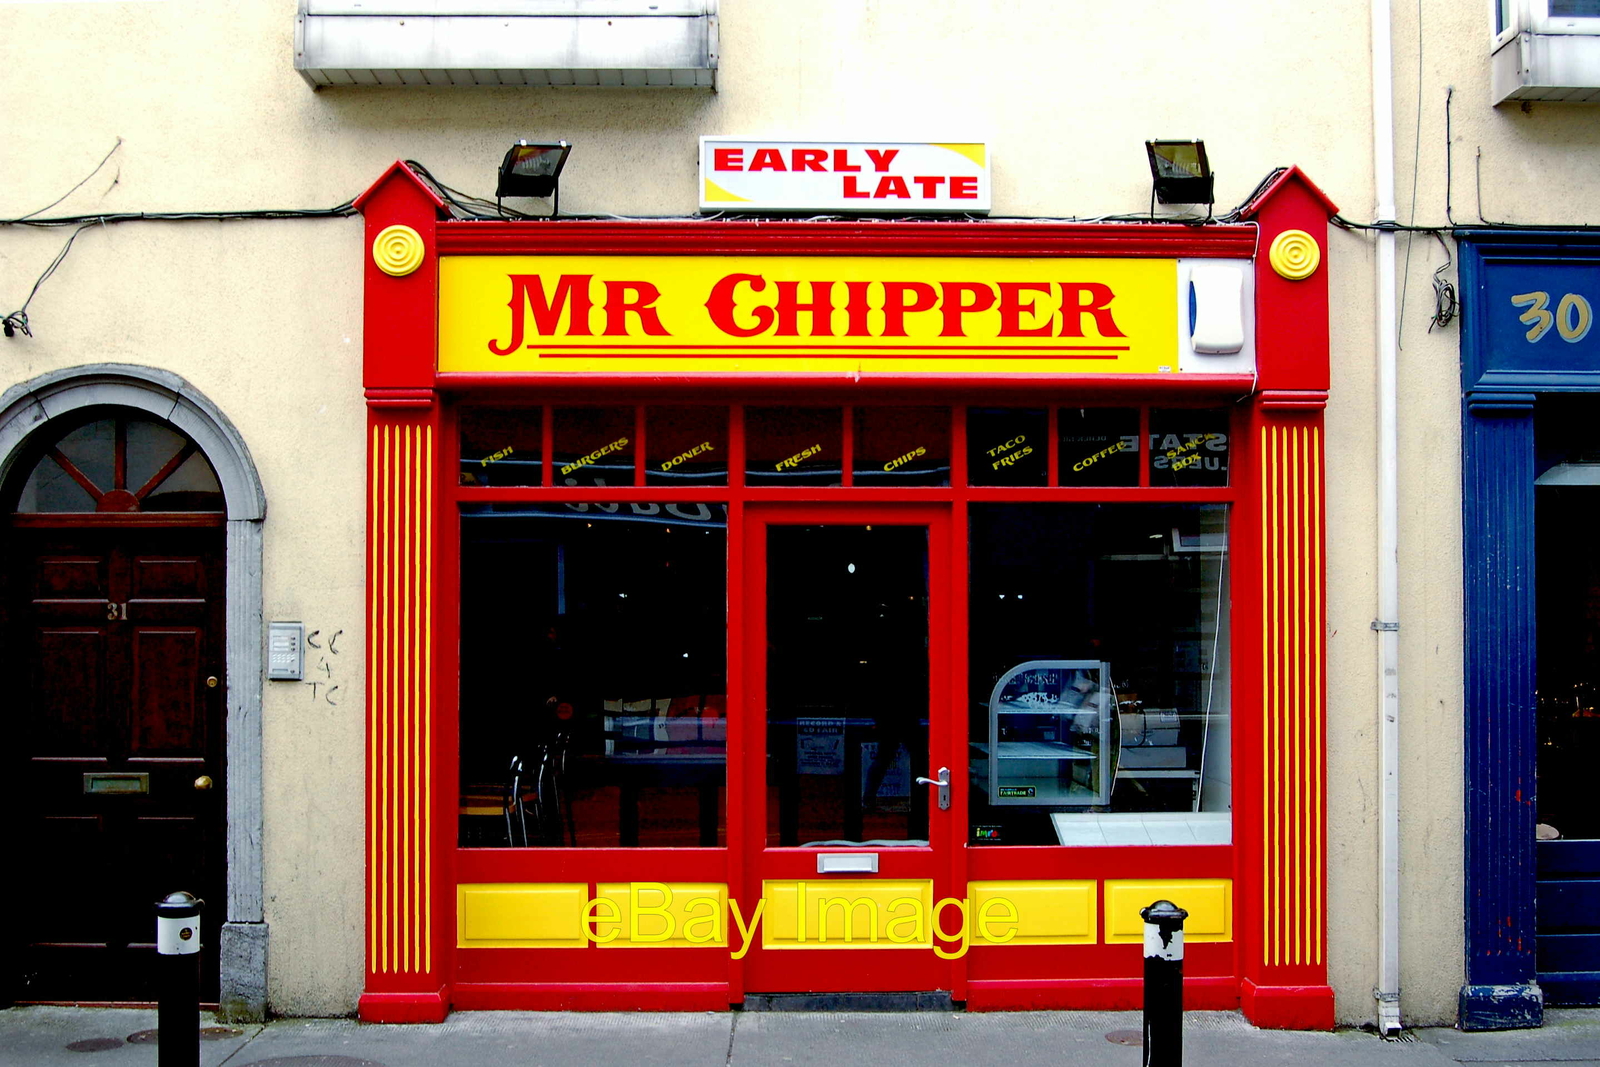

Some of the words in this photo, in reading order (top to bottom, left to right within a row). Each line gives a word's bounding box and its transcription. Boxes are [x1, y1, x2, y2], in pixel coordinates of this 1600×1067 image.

[714, 148, 900, 173] EARLY
[843, 175, 979, 200] LATE
[487, 273, 671, 357] MR
[703, 272, 1127, 339] CHIPPER
[1511, 291, 1593, 343] 30
[480, 446, 514, 467] FISH
[561, 437, 629, 475] BURGERS
[661, 441, 714, 472] DONER
[775, 444, 822, 472] FRESH
[986, 434, 1026, 458] TACO
[992, 446, 1033, 471] FRIES
[1073, 441, 1127, 472] COFFEE
[883, 446, 927, 472] CHIPS
[1171, 452, 1202, 471] BOX
[106, 602, 129, 621] 31
